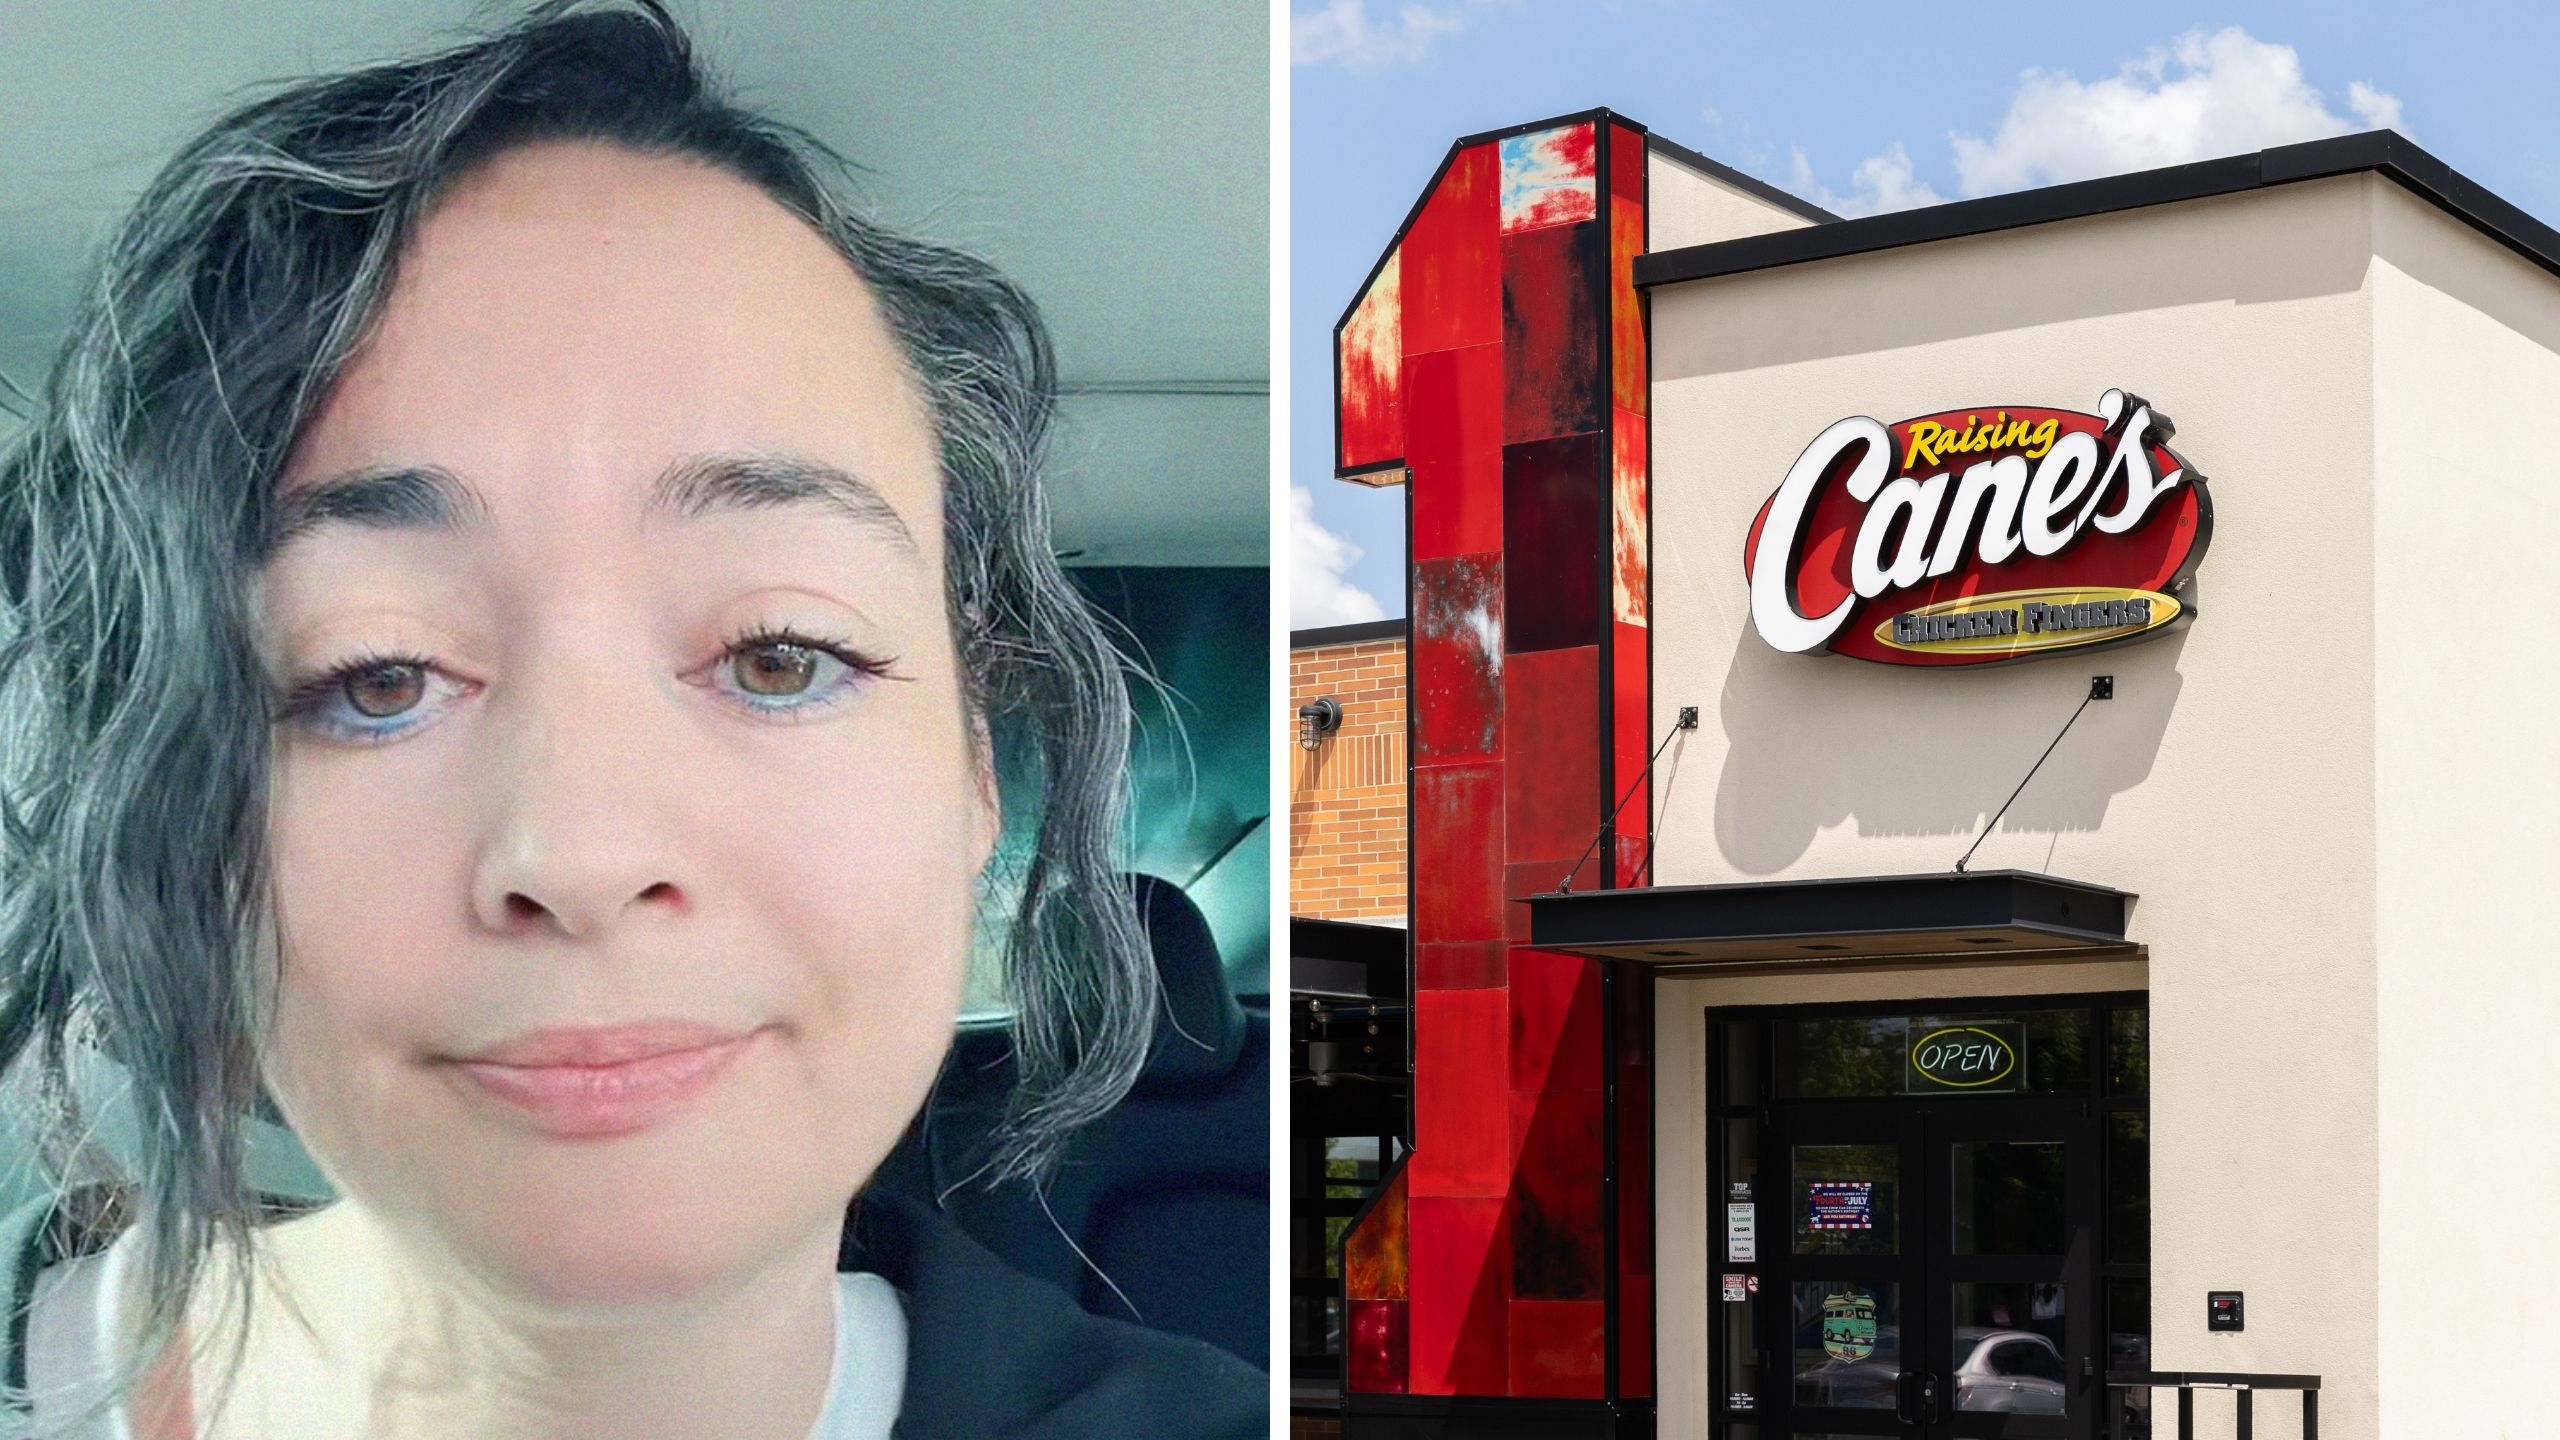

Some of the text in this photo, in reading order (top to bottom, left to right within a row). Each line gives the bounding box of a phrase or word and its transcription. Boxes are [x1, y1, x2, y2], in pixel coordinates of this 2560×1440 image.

[1904, 411, 2059, 470] Raising
[1750, 387, 2183, 654] Cane's
[1892, 597, 2151, 646] CHICKEN FINGERS
[1921, 1043, 2002, 1071] OPEN
[1848, 1196, 1868, 1205] JULY
